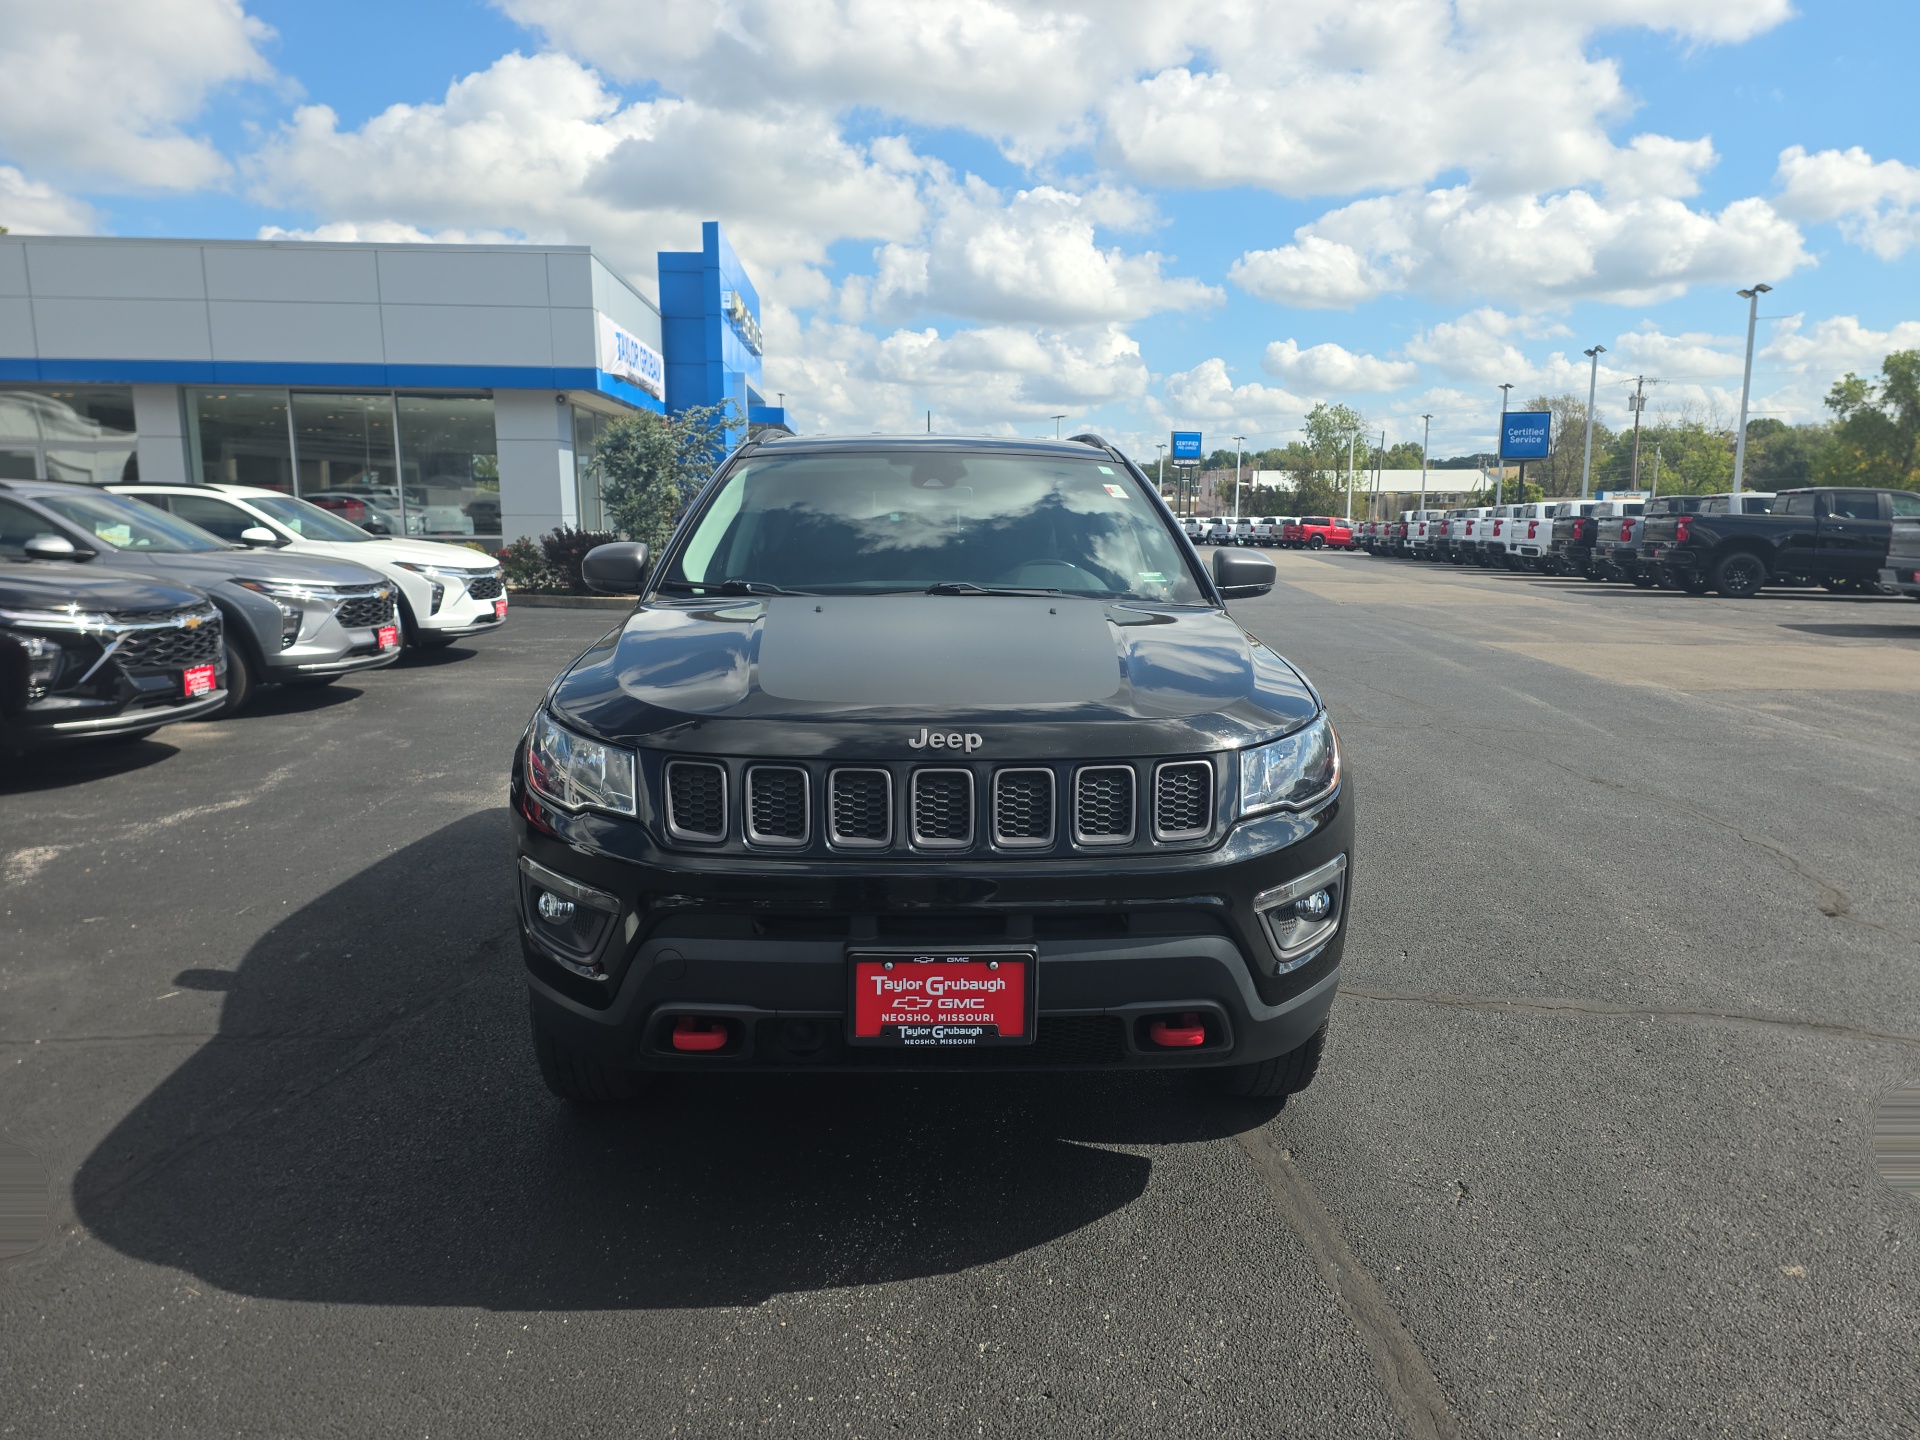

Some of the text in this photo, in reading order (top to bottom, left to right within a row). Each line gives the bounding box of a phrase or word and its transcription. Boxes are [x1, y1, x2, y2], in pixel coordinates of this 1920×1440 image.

[1508, 428, 1545, 436] Certified
[908, 728, 983, 753] Jeep
[870, 975, 1006, 996] Taylor Grubaugh
[937, 998, 985, 1009] GMC
[882, 1013, 994, 1023] NEOSHO, MISSOURI
[898, 1025, 983, 1039] Taylor Grubaugh
